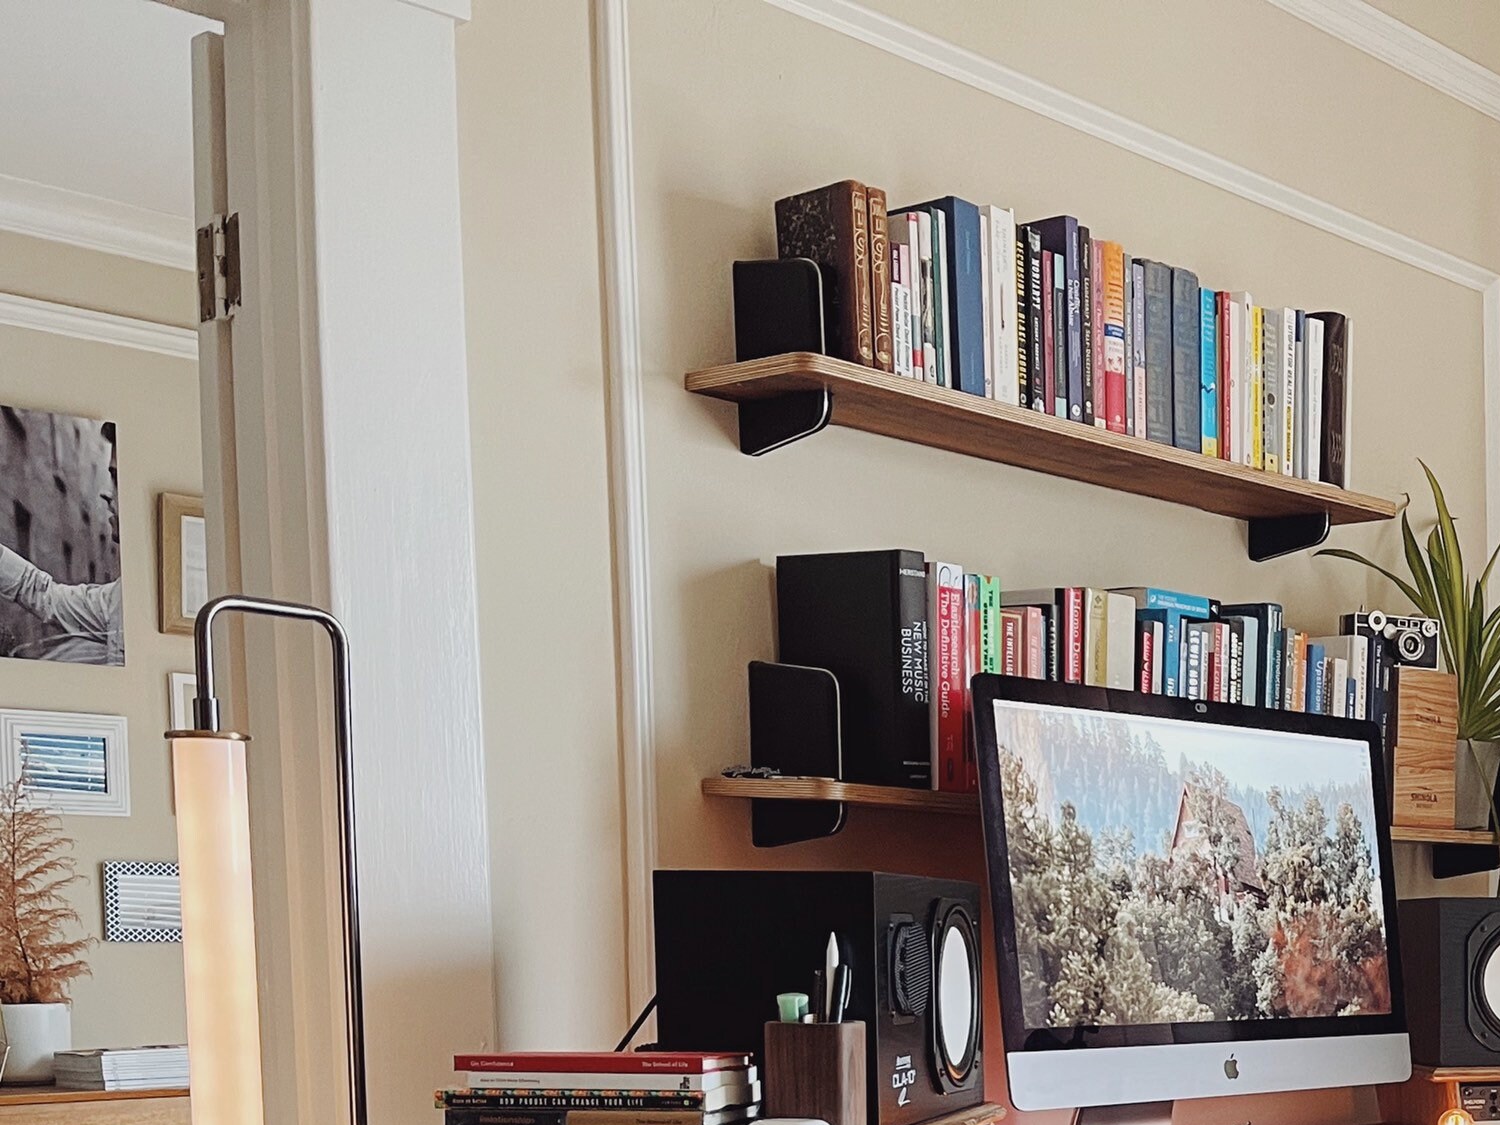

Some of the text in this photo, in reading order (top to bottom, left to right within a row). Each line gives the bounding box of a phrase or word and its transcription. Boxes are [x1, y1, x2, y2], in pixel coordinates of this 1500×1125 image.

[1016, 241, 1024, 296] RECURSION
[1031, 258, 1041, 310] MORIARTY
[1018, 347, 1027, 385] CROUCH
[901, 628, 913, 694] BUSINESS
[913, 621, 924, 702] NEW MUSIC
[940, 591, 950, 718] The Definitive Guide
[950, 592, 960, 679] Elasticsearch:
[1006, 622, 1014, 676] THE INTELLIGE
[1073, 598, 1081, 674] Homo Deus
[1189, 630, 1200, 666] LEWIS
[1315, 661, 1323, 711] Upstream
[552, 1098, 567, 1106] CAN
[571, 1098, 600, 1106] CHANGE
